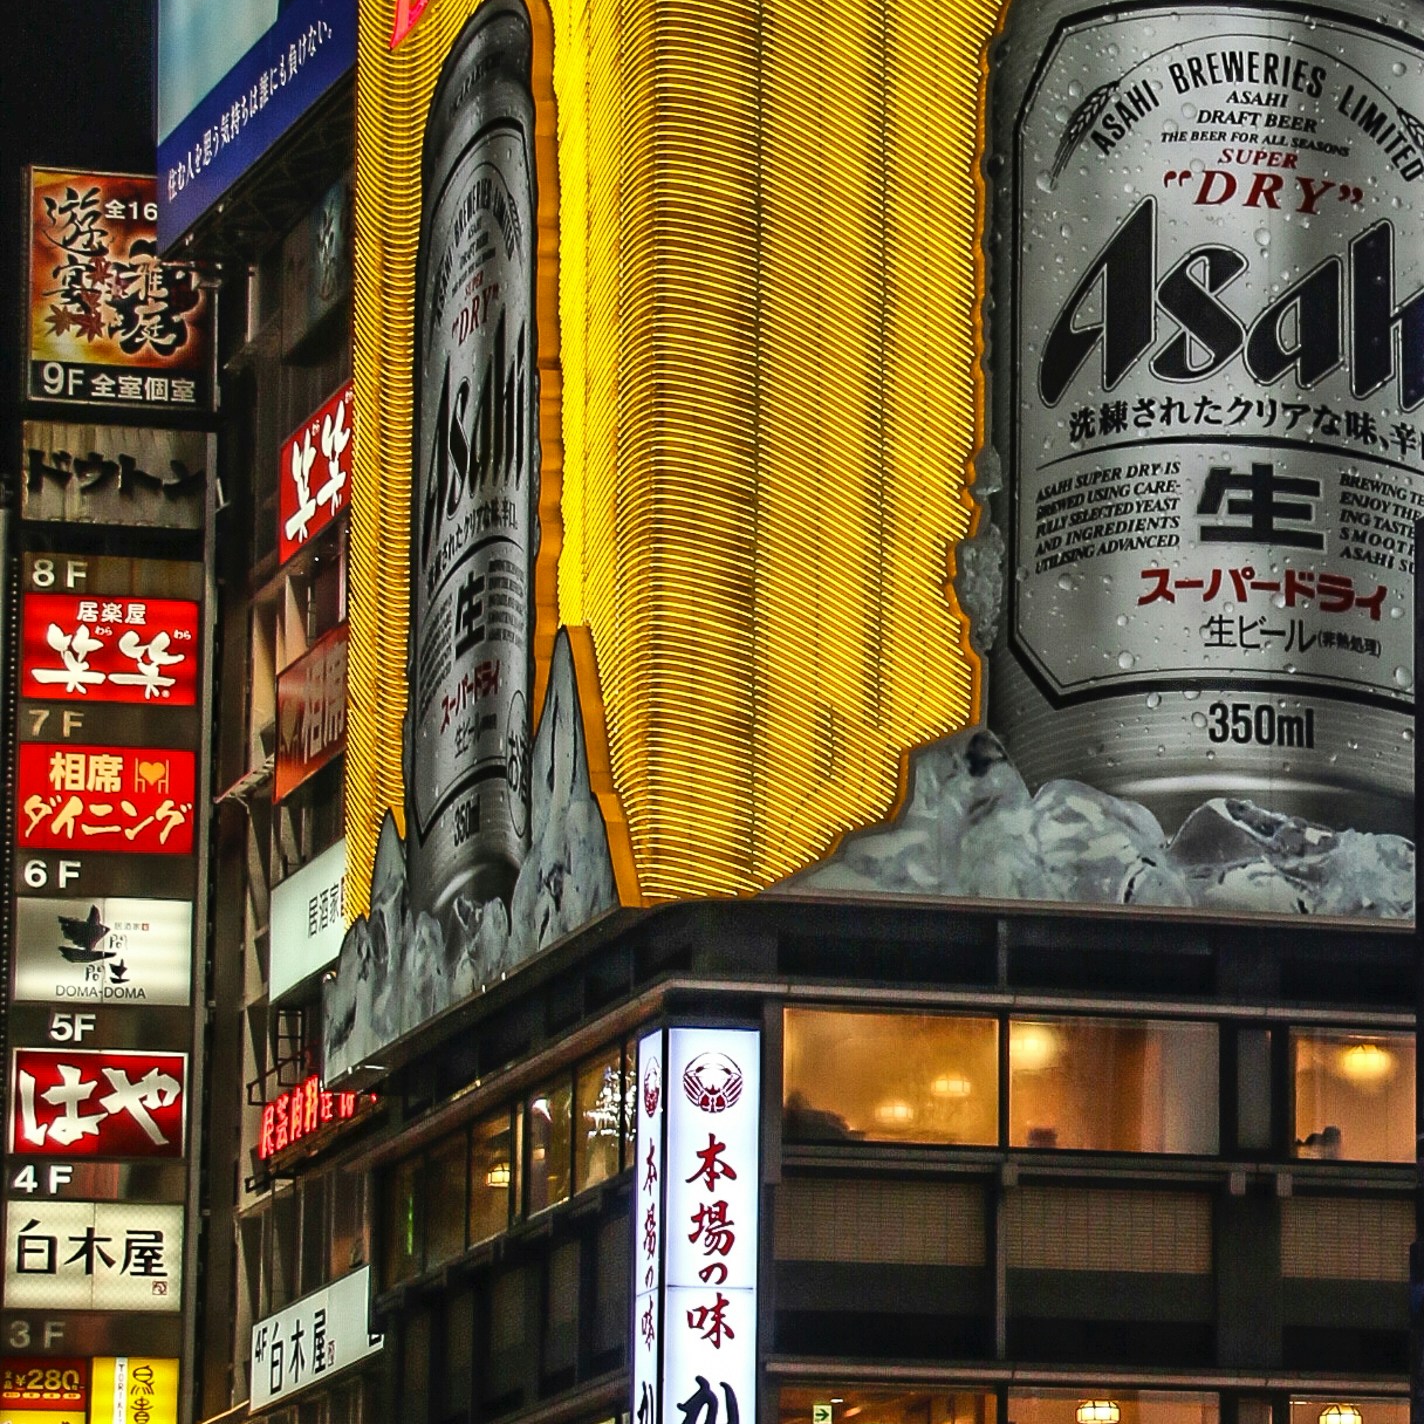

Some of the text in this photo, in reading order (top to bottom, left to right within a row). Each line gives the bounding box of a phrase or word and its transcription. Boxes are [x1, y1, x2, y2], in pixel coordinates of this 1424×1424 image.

[1090, 78, 1162, 158] ASAHI
[1168, 49, 1328, 99] BREWERIES
[1226, 90, 1290, 109] ASAHI
[1197, 109, 1319, 134] DRAFT BEER
[1161, 131, 1351, 158] THE BEER FOR ALL SEASONS
[1218, 147, 1299, 169] SUPER
[43, 361, 197, 403] 9F 全室個室
[285, 399, 351, 544] 笑笑
[1036, 461, 1182, 503] ASAHI SUPER DRY IS
[1339, 473, 1408, 502] BREWING
[1035, 479, 1182, 521] BREWED USING CARE-
[1068, 501, 1135, 527] SELECTED
[1136, 497, 1182, 514] YEAST
[1197, 461, 1327, 552] 生
[1339, 491, 1392, 514] ENJOY
[1339, 508, 1371, 527] ING
[1035, 515, 1182, 558] AND INGREDIENTS
[1035, 534, 1181, 575] UTILISING ADVANCED
[1339, 545, 1395, 570] ASAHI
[75, 601, 148, 625] 居楽屋
[1136, 566, 1388, 621] スーパードライ
[454, 569, 487, 661] 生
[1202, 613, 1318, 653] 生ビール
[31, 623, 186, 699] 笑笑
[1207, 702, 1316, 750] 350ml
[48, 752, 123, 794] 相席
[22, 793, 194, 845] ダイニング
[55, 984, 147, 999] DOMA-DOMA
[49, 1013, 97, 1043] 5F
[18, 1061, 183, 1148] はや
[15, 1218, 168, 1279] 白木屋
[640, 1136, 661, 1354] 本場の味
[684, 1133, 737, 1351] 本場の味
[269, 1307, 328, 1396] 白木屋
